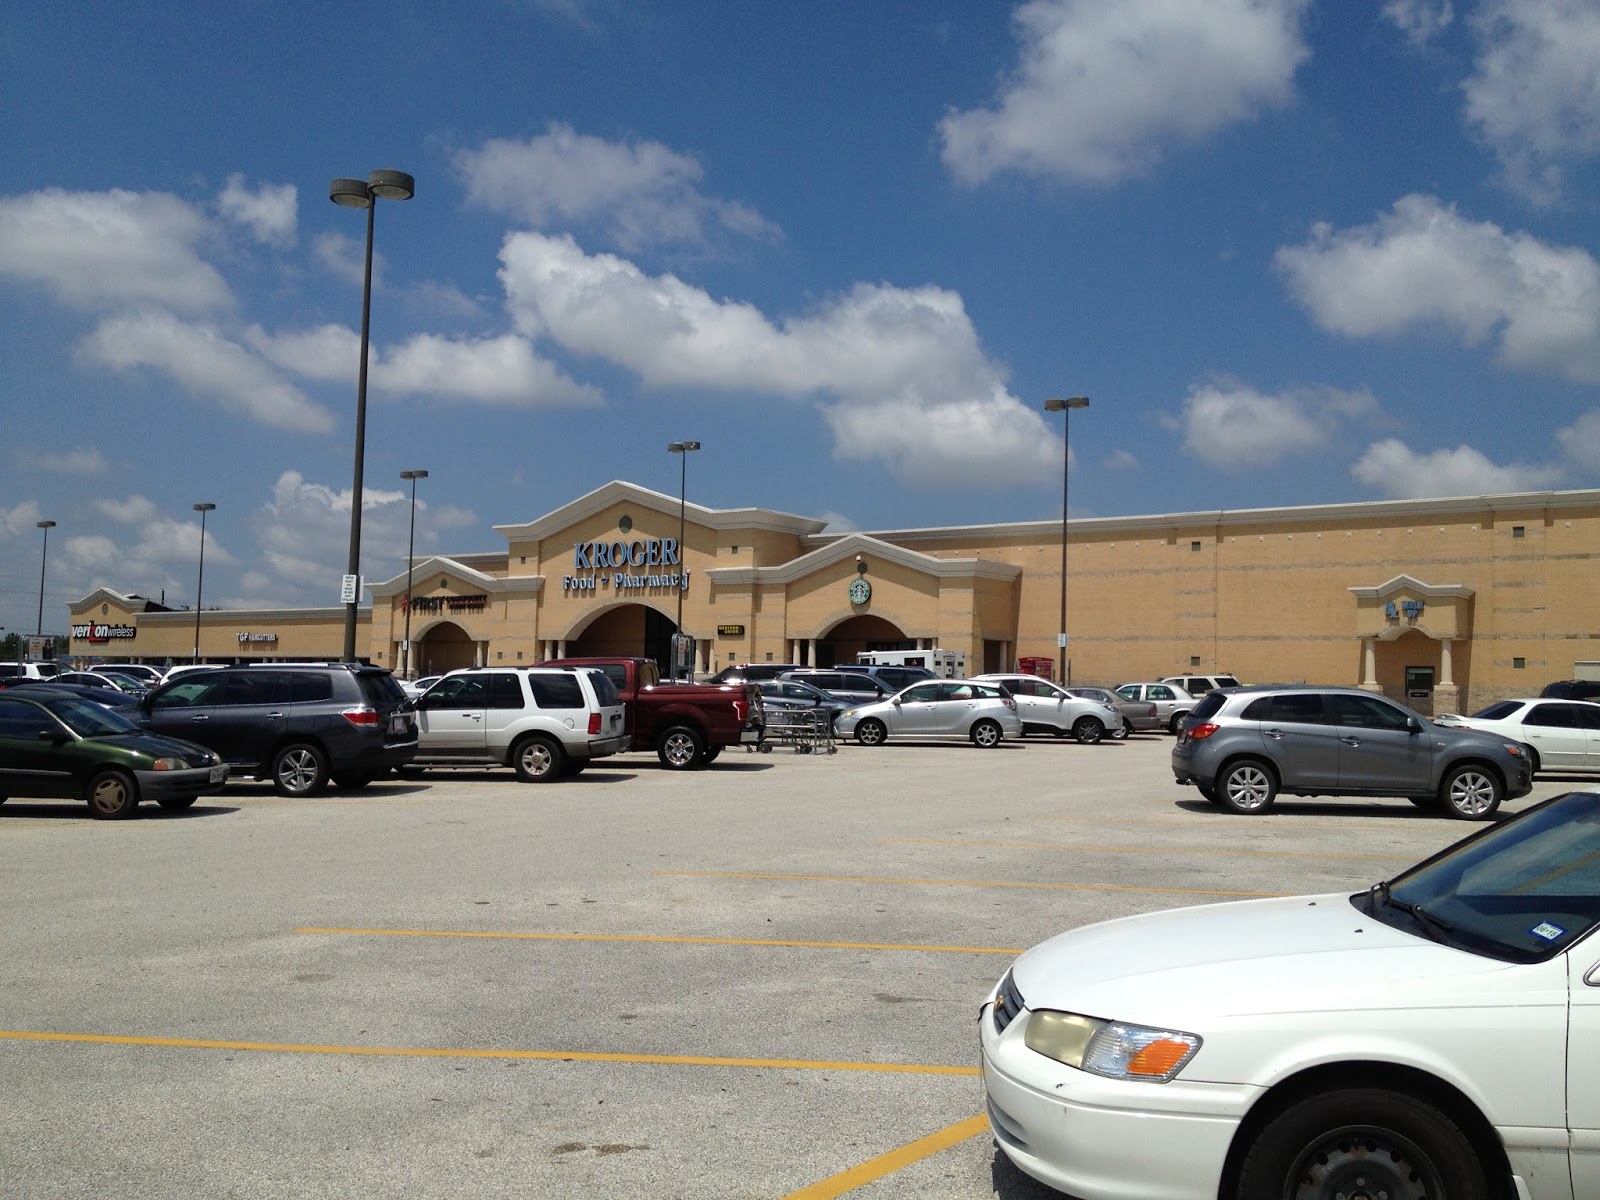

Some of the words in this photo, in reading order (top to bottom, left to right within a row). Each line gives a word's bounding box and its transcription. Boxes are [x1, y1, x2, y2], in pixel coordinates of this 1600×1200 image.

[574, 538, 679, 569] KROGER
[563, 574, 596, 590] Food
[613, 572, 689, 590] Pharmacy
[411, 596, 445, 610] FIRST
[72, 621, 109, 641] verizon
[108, 625, 136, 638] wireless
